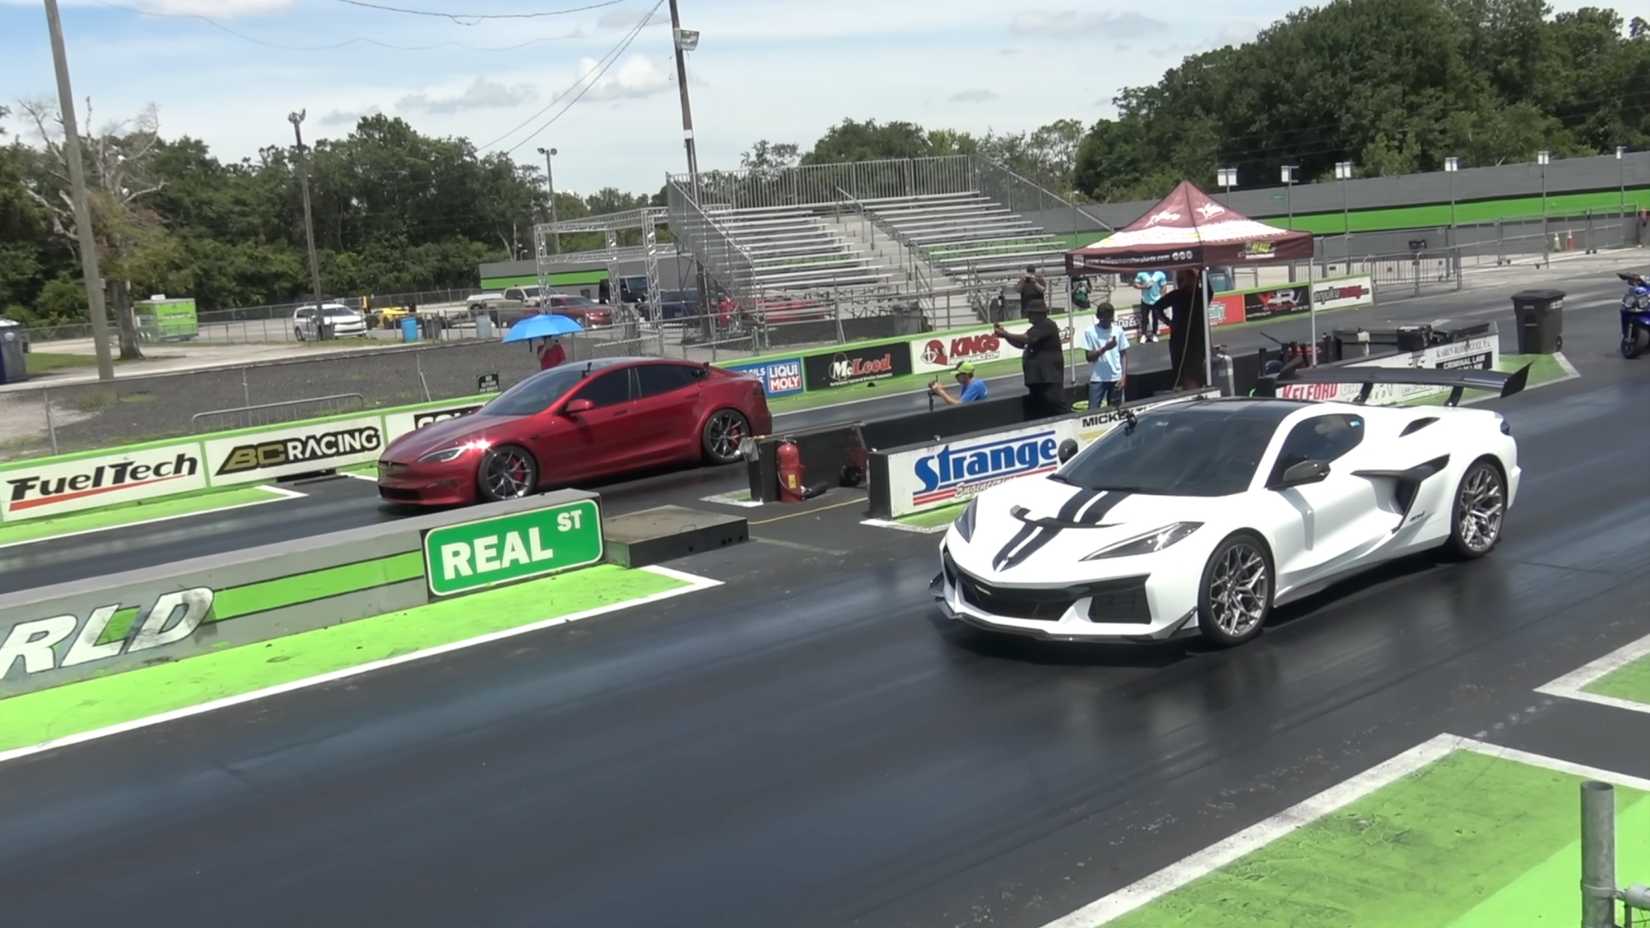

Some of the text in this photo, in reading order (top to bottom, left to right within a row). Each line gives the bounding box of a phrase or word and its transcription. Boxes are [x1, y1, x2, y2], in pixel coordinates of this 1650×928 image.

[950, 333, 1001, 358] KINGS
[769, 364, 799, 378] LIQUI
[832, 352, 893, 379] McLeod
[770, 376, 799, 391] MOLY
[286, 427, 381, 461] RACING
[6, 452, 199, 502] FuelTech
[914, 437, 1058, 493] Strange
[441, 509, 582, 582] REAL ST
